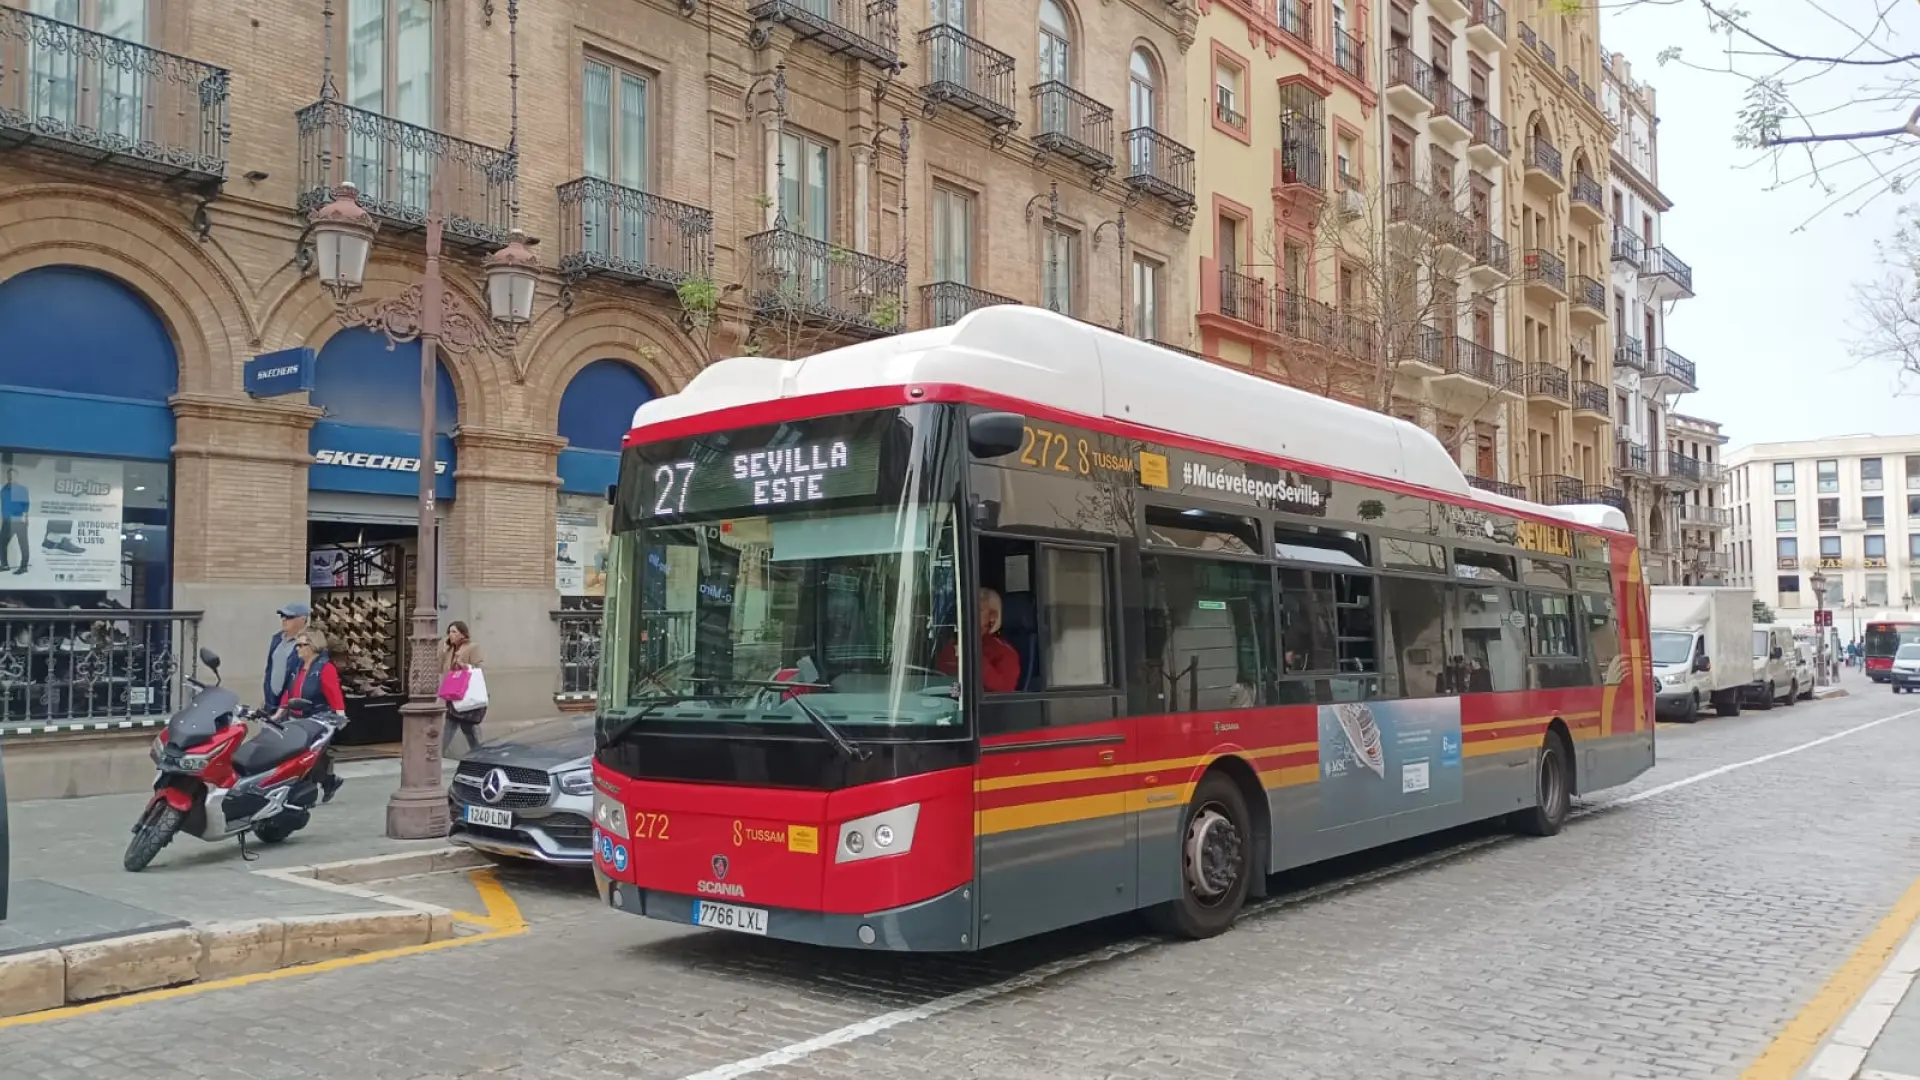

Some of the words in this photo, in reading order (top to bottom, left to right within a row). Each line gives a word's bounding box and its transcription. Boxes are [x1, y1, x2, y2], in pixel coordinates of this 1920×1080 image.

[257, 364, 299, 380] SKECHERS
[316, 449, 448, 474] SKECHES
[733, 441, 848, 480] SEVILLA
[1020, 427, 1070, 472] 272
[1092, 451, 1133, 473] TUSSAM
[654, 461, 696, 515] 27
[754, 474, 825, 505] ESTE
[1183, 462, 1321, 506] #MuéveteporSevilla
[83, 537, 105, 545] LISTO
[88, 529, 101, 538] PIE
[634, 812, 670, 840] 272
[745, 828, 786, 844] TUSSAM
[697, 880, 745, 897] SCANIA
[701, 903, 734, 926] 7766
[738, 909, 763, 931] LXL
